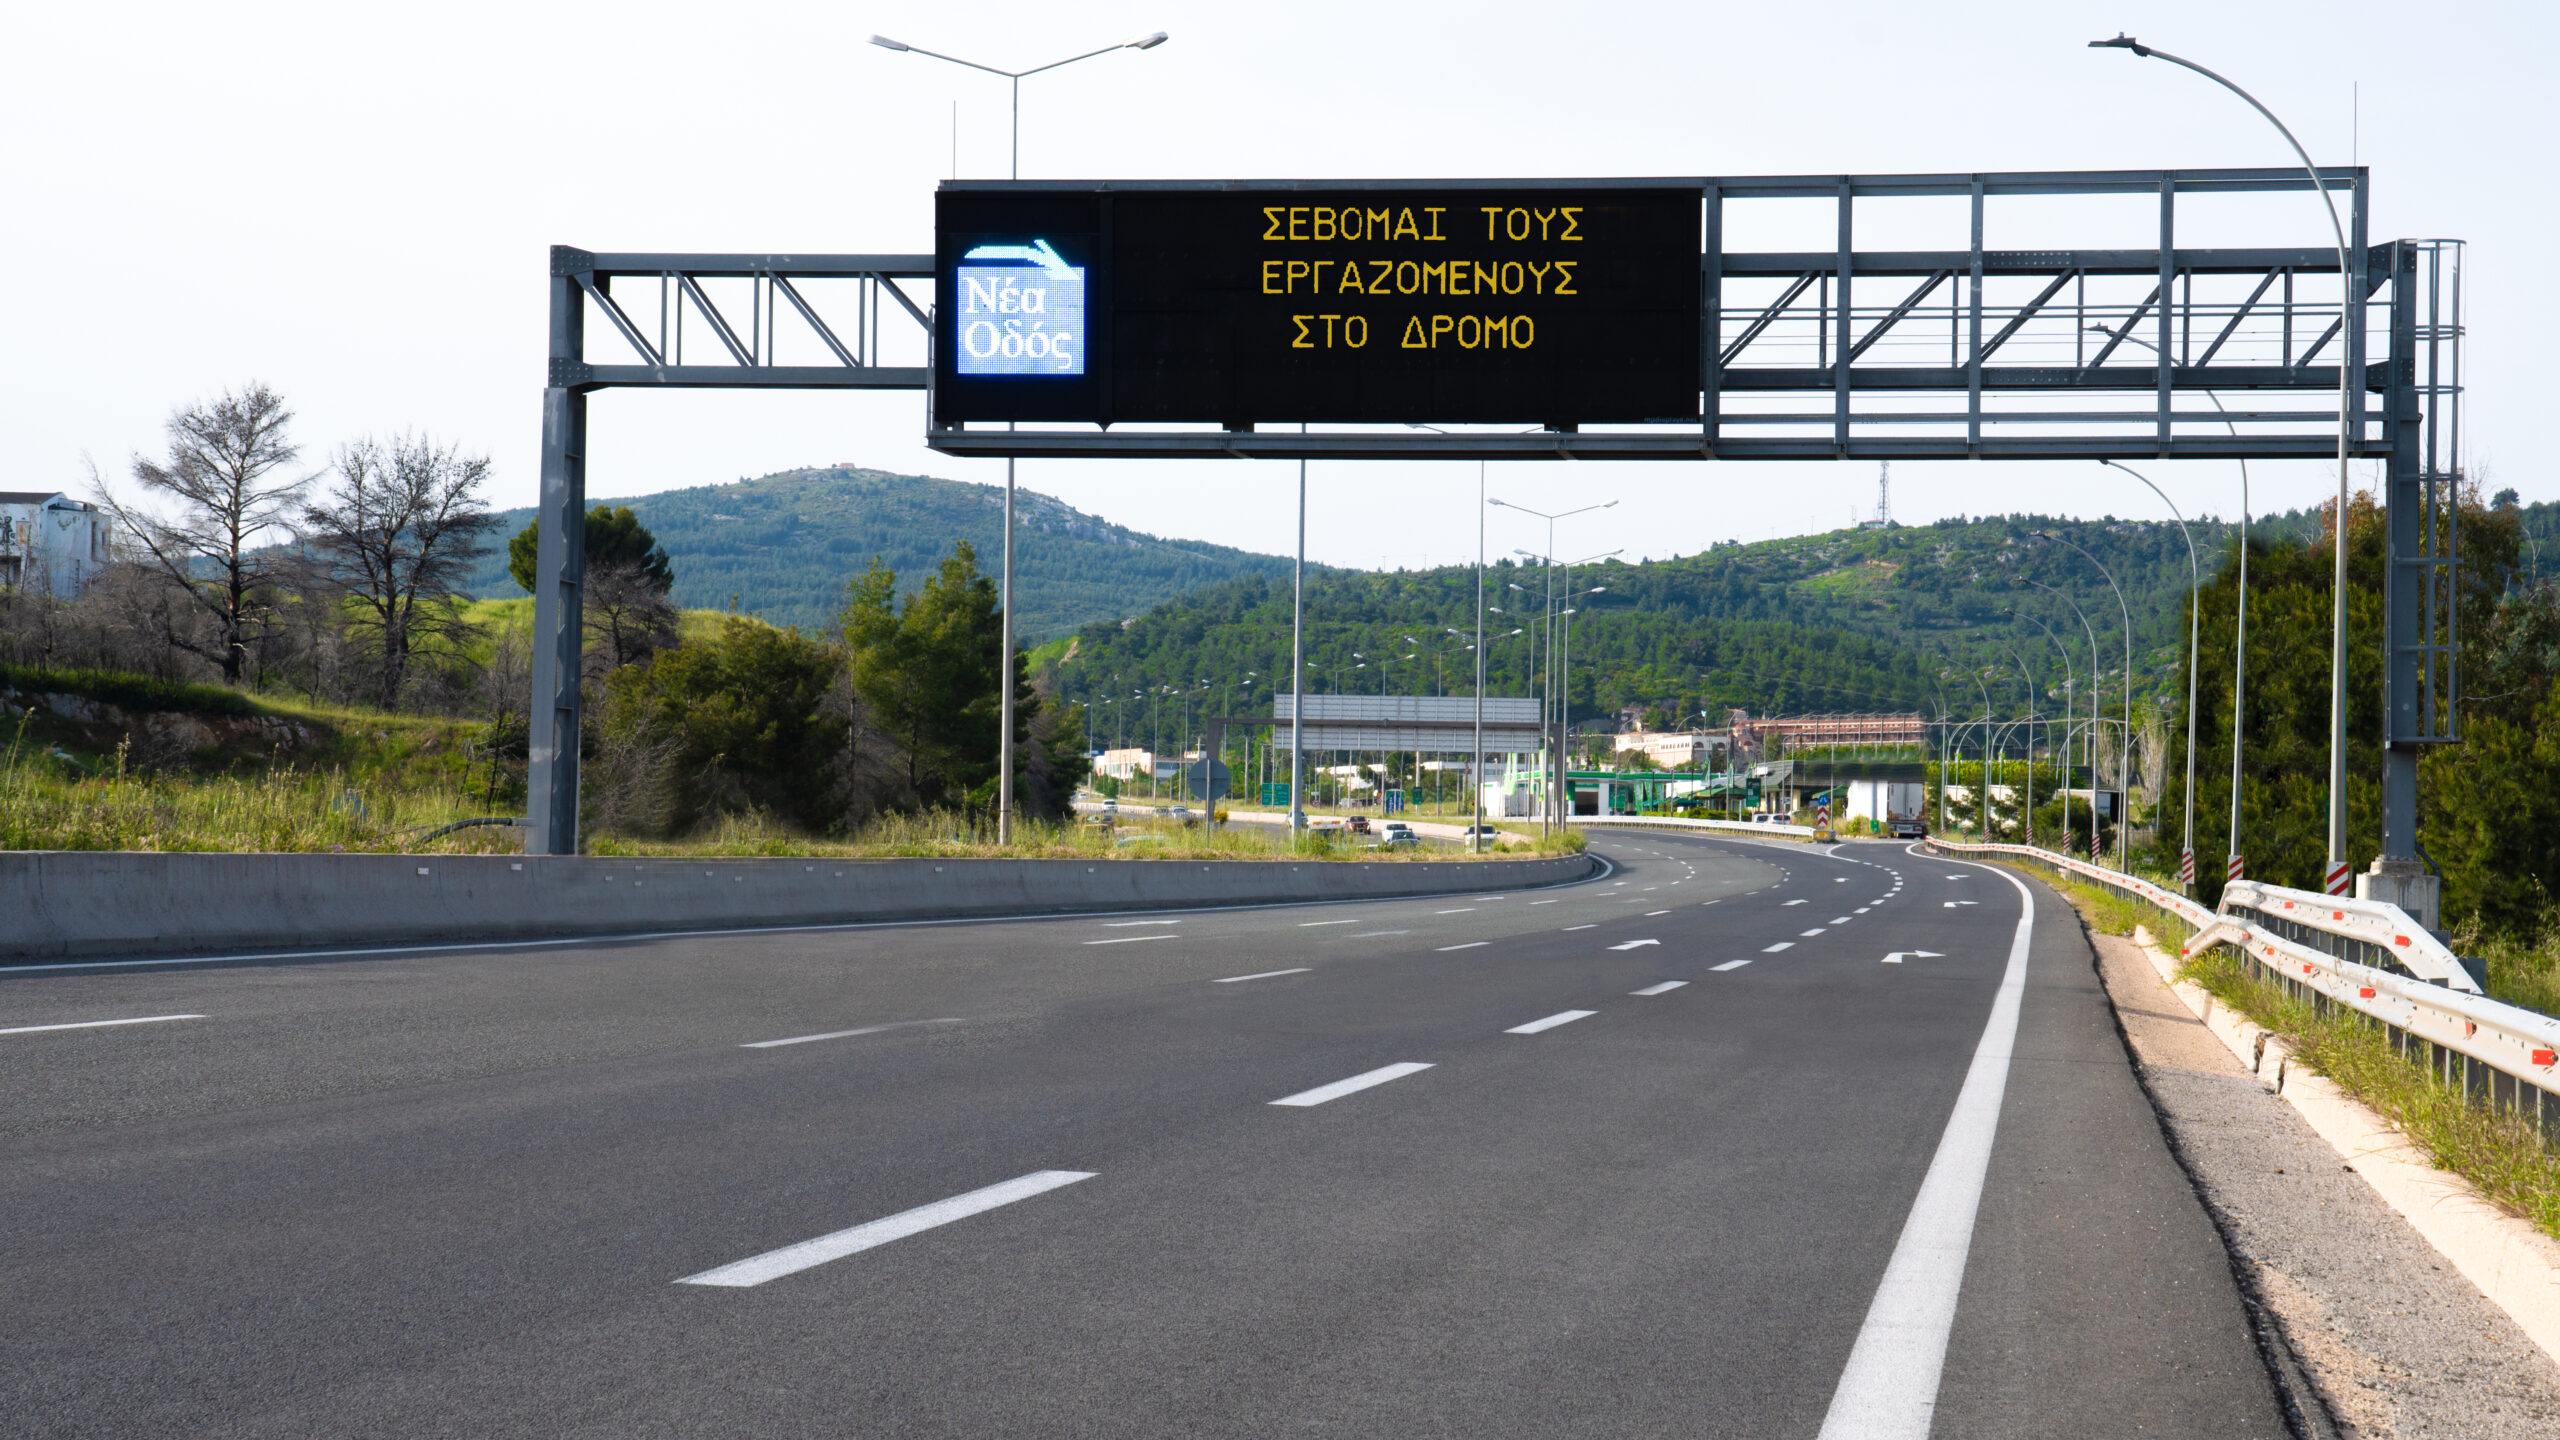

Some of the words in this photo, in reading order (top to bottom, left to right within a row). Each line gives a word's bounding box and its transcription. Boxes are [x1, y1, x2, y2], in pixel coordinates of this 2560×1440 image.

[1262, 206, 1447, 241] ΣΕΒΟΜΑΙ
[1480, 206, 1584, 241] ΤΟΥΣ
[963, 276, 1046, 313] Νέα
[1262, 260, 1578, 295] ΕΡΓΑΖΟΜΕΝΟΥΣ
[965, 319, 1072, 369] Οδός
[1291, 314, 1368, 349] ΣΤΟ
[1401, 314, 1534, 349] ΔΡΟΜΟ
